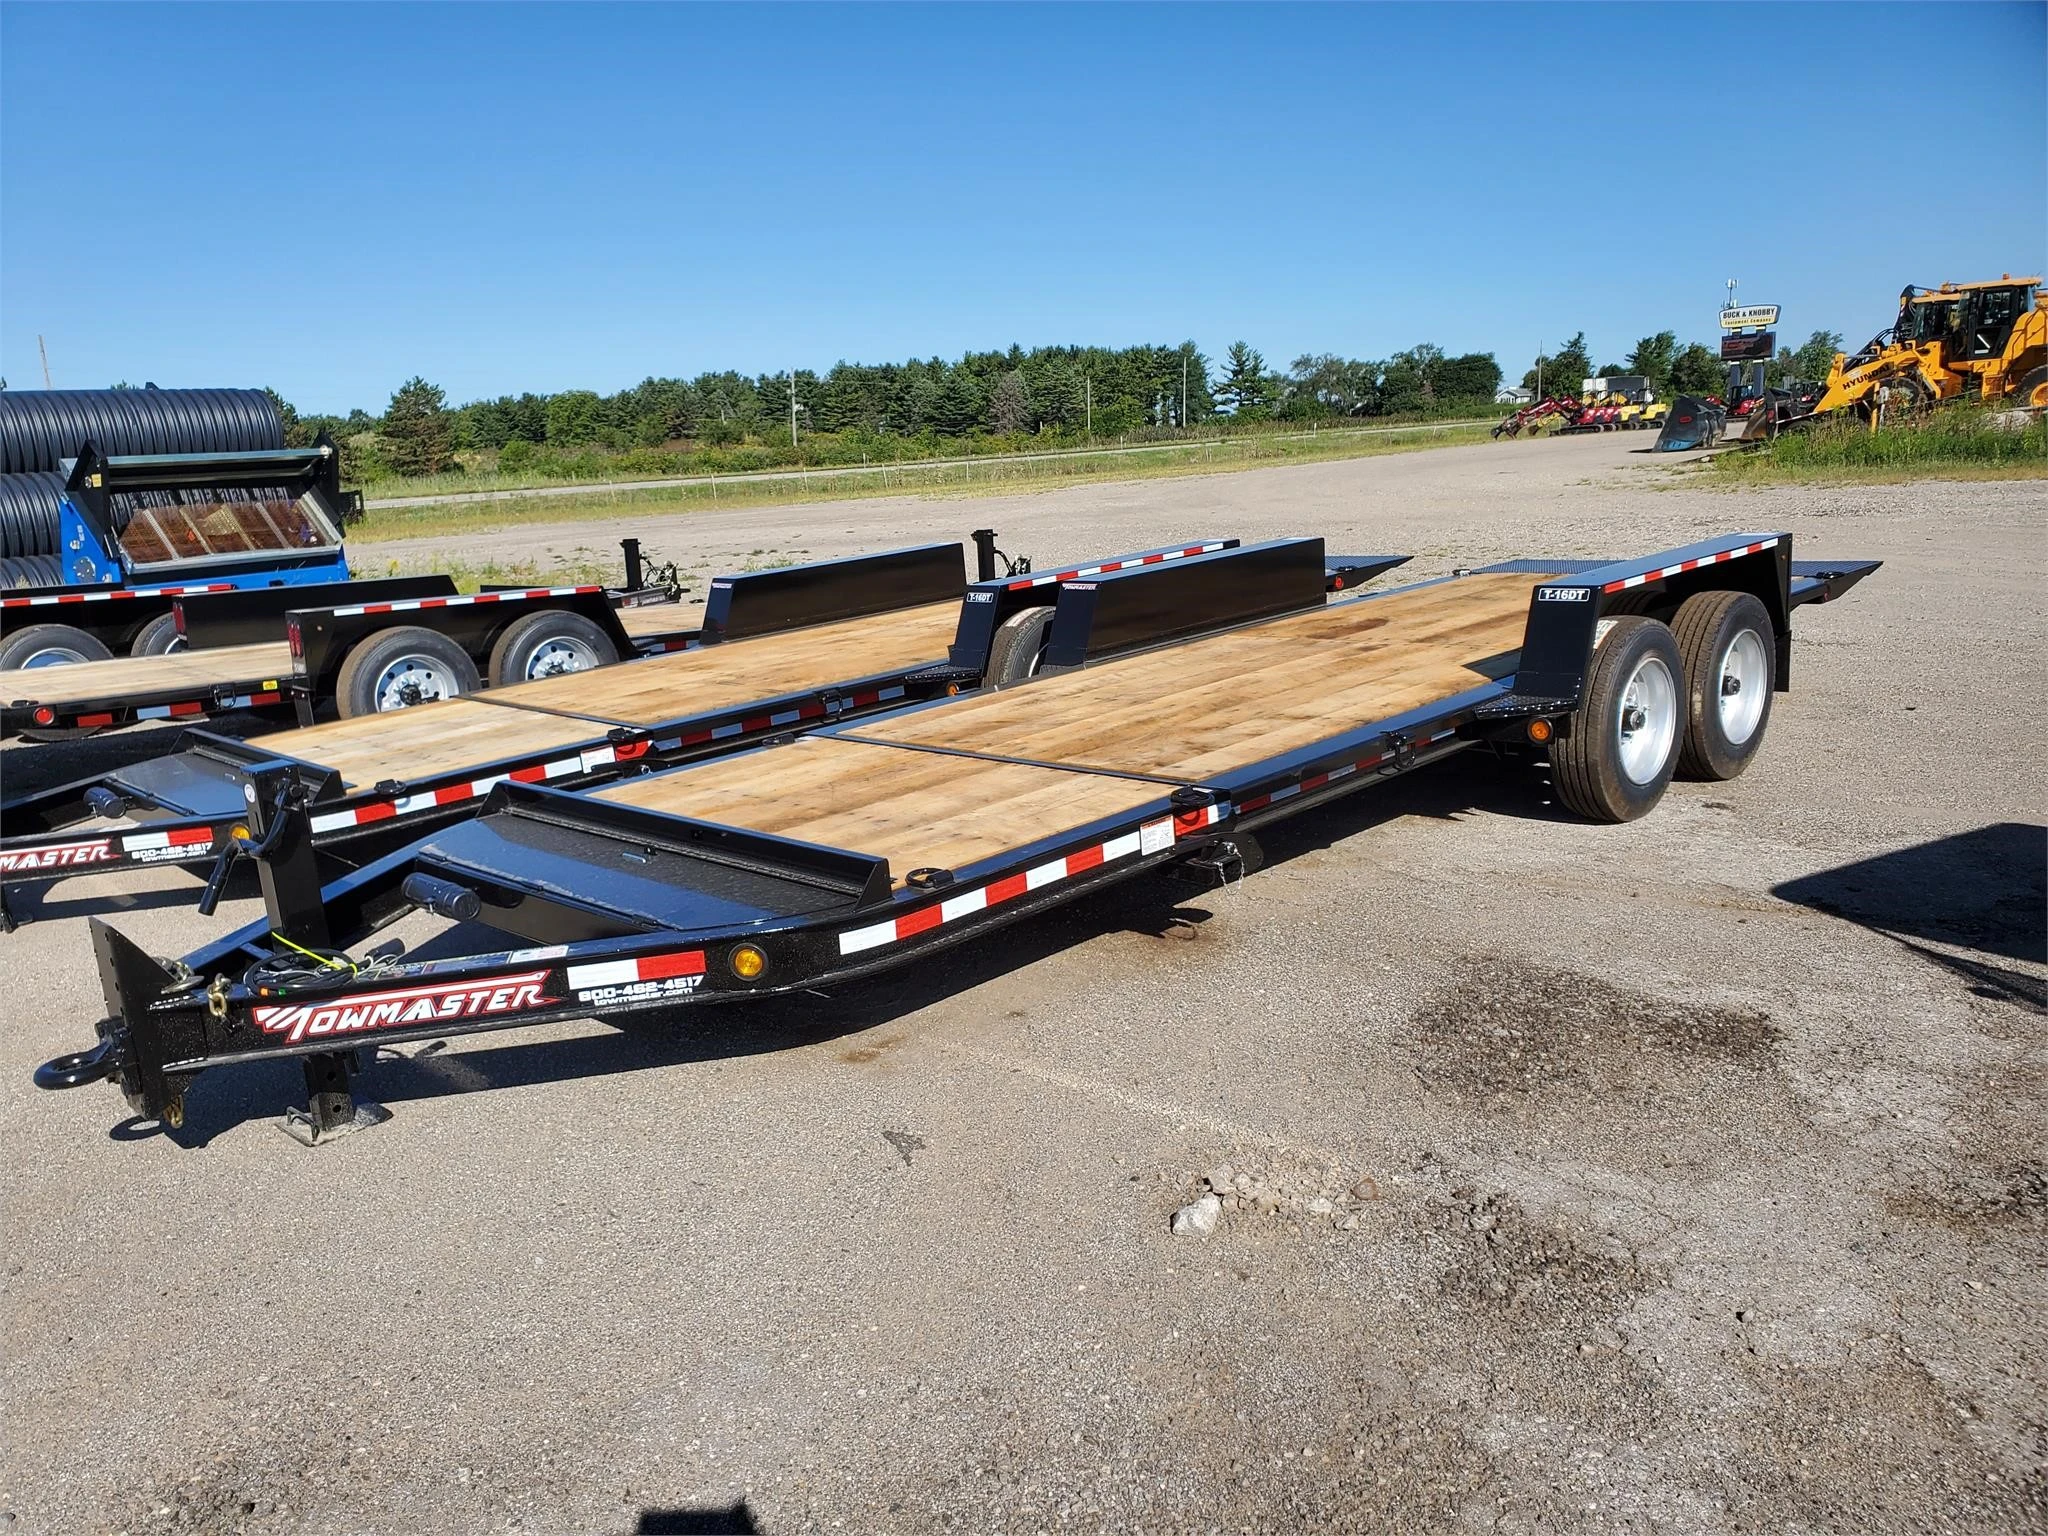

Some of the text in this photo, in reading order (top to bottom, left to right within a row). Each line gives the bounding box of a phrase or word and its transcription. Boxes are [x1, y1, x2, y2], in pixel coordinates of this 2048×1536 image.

[1723, 310, 1740, 319] BUCK
[1748, 308, 1775, 317] KNOBBY
[1842, 364, 1890, 390] HYUNDAI
[1544, 590, 1585, 600] T-16DT
[578, 975, 704, 1002] 800-462-4517
[593, 987, 693, 1006] towmaster.com
[253, 971, 555, 1042] TOWMASTER
